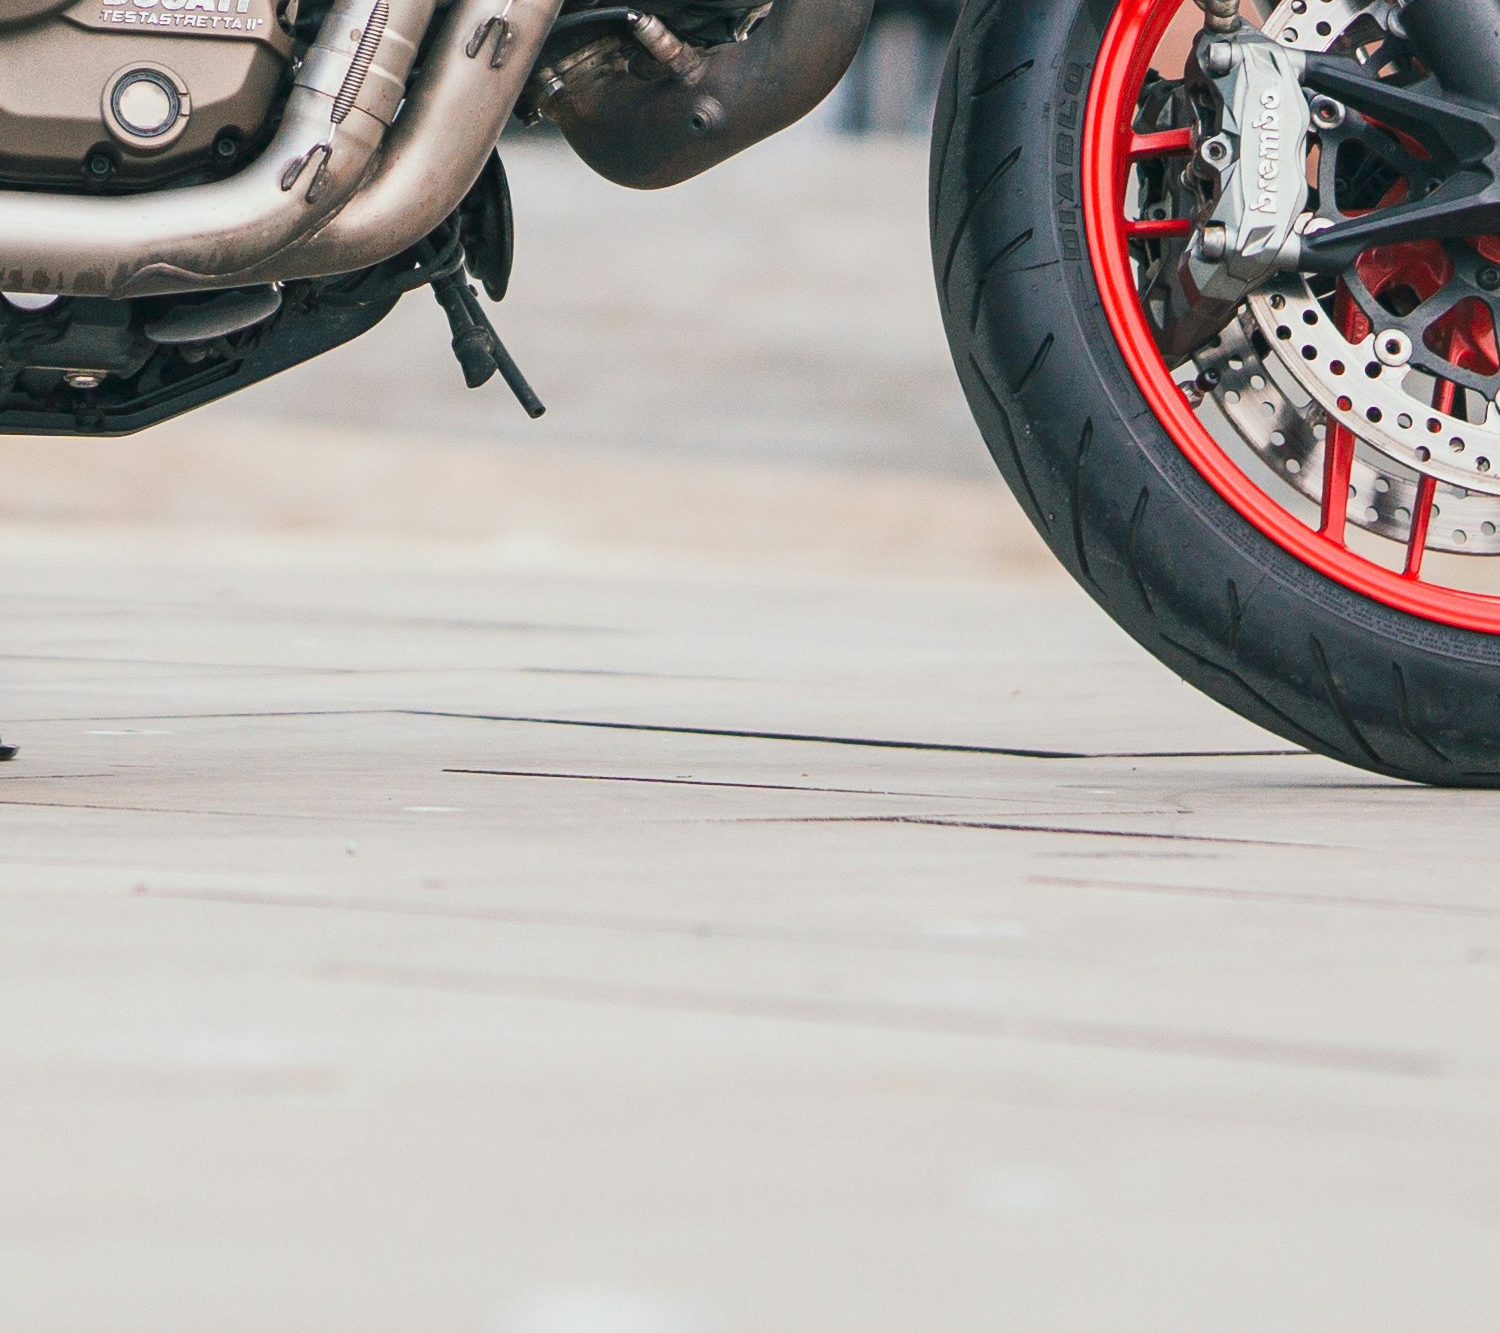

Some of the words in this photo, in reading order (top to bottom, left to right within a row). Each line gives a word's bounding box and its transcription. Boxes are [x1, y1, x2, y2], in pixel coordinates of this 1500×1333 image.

[100, 9, 242, 30] TESTASTRETTA
[1056, 62, 1085, 261] DIABLO
[1249, 88, 1281, 213] brembo
